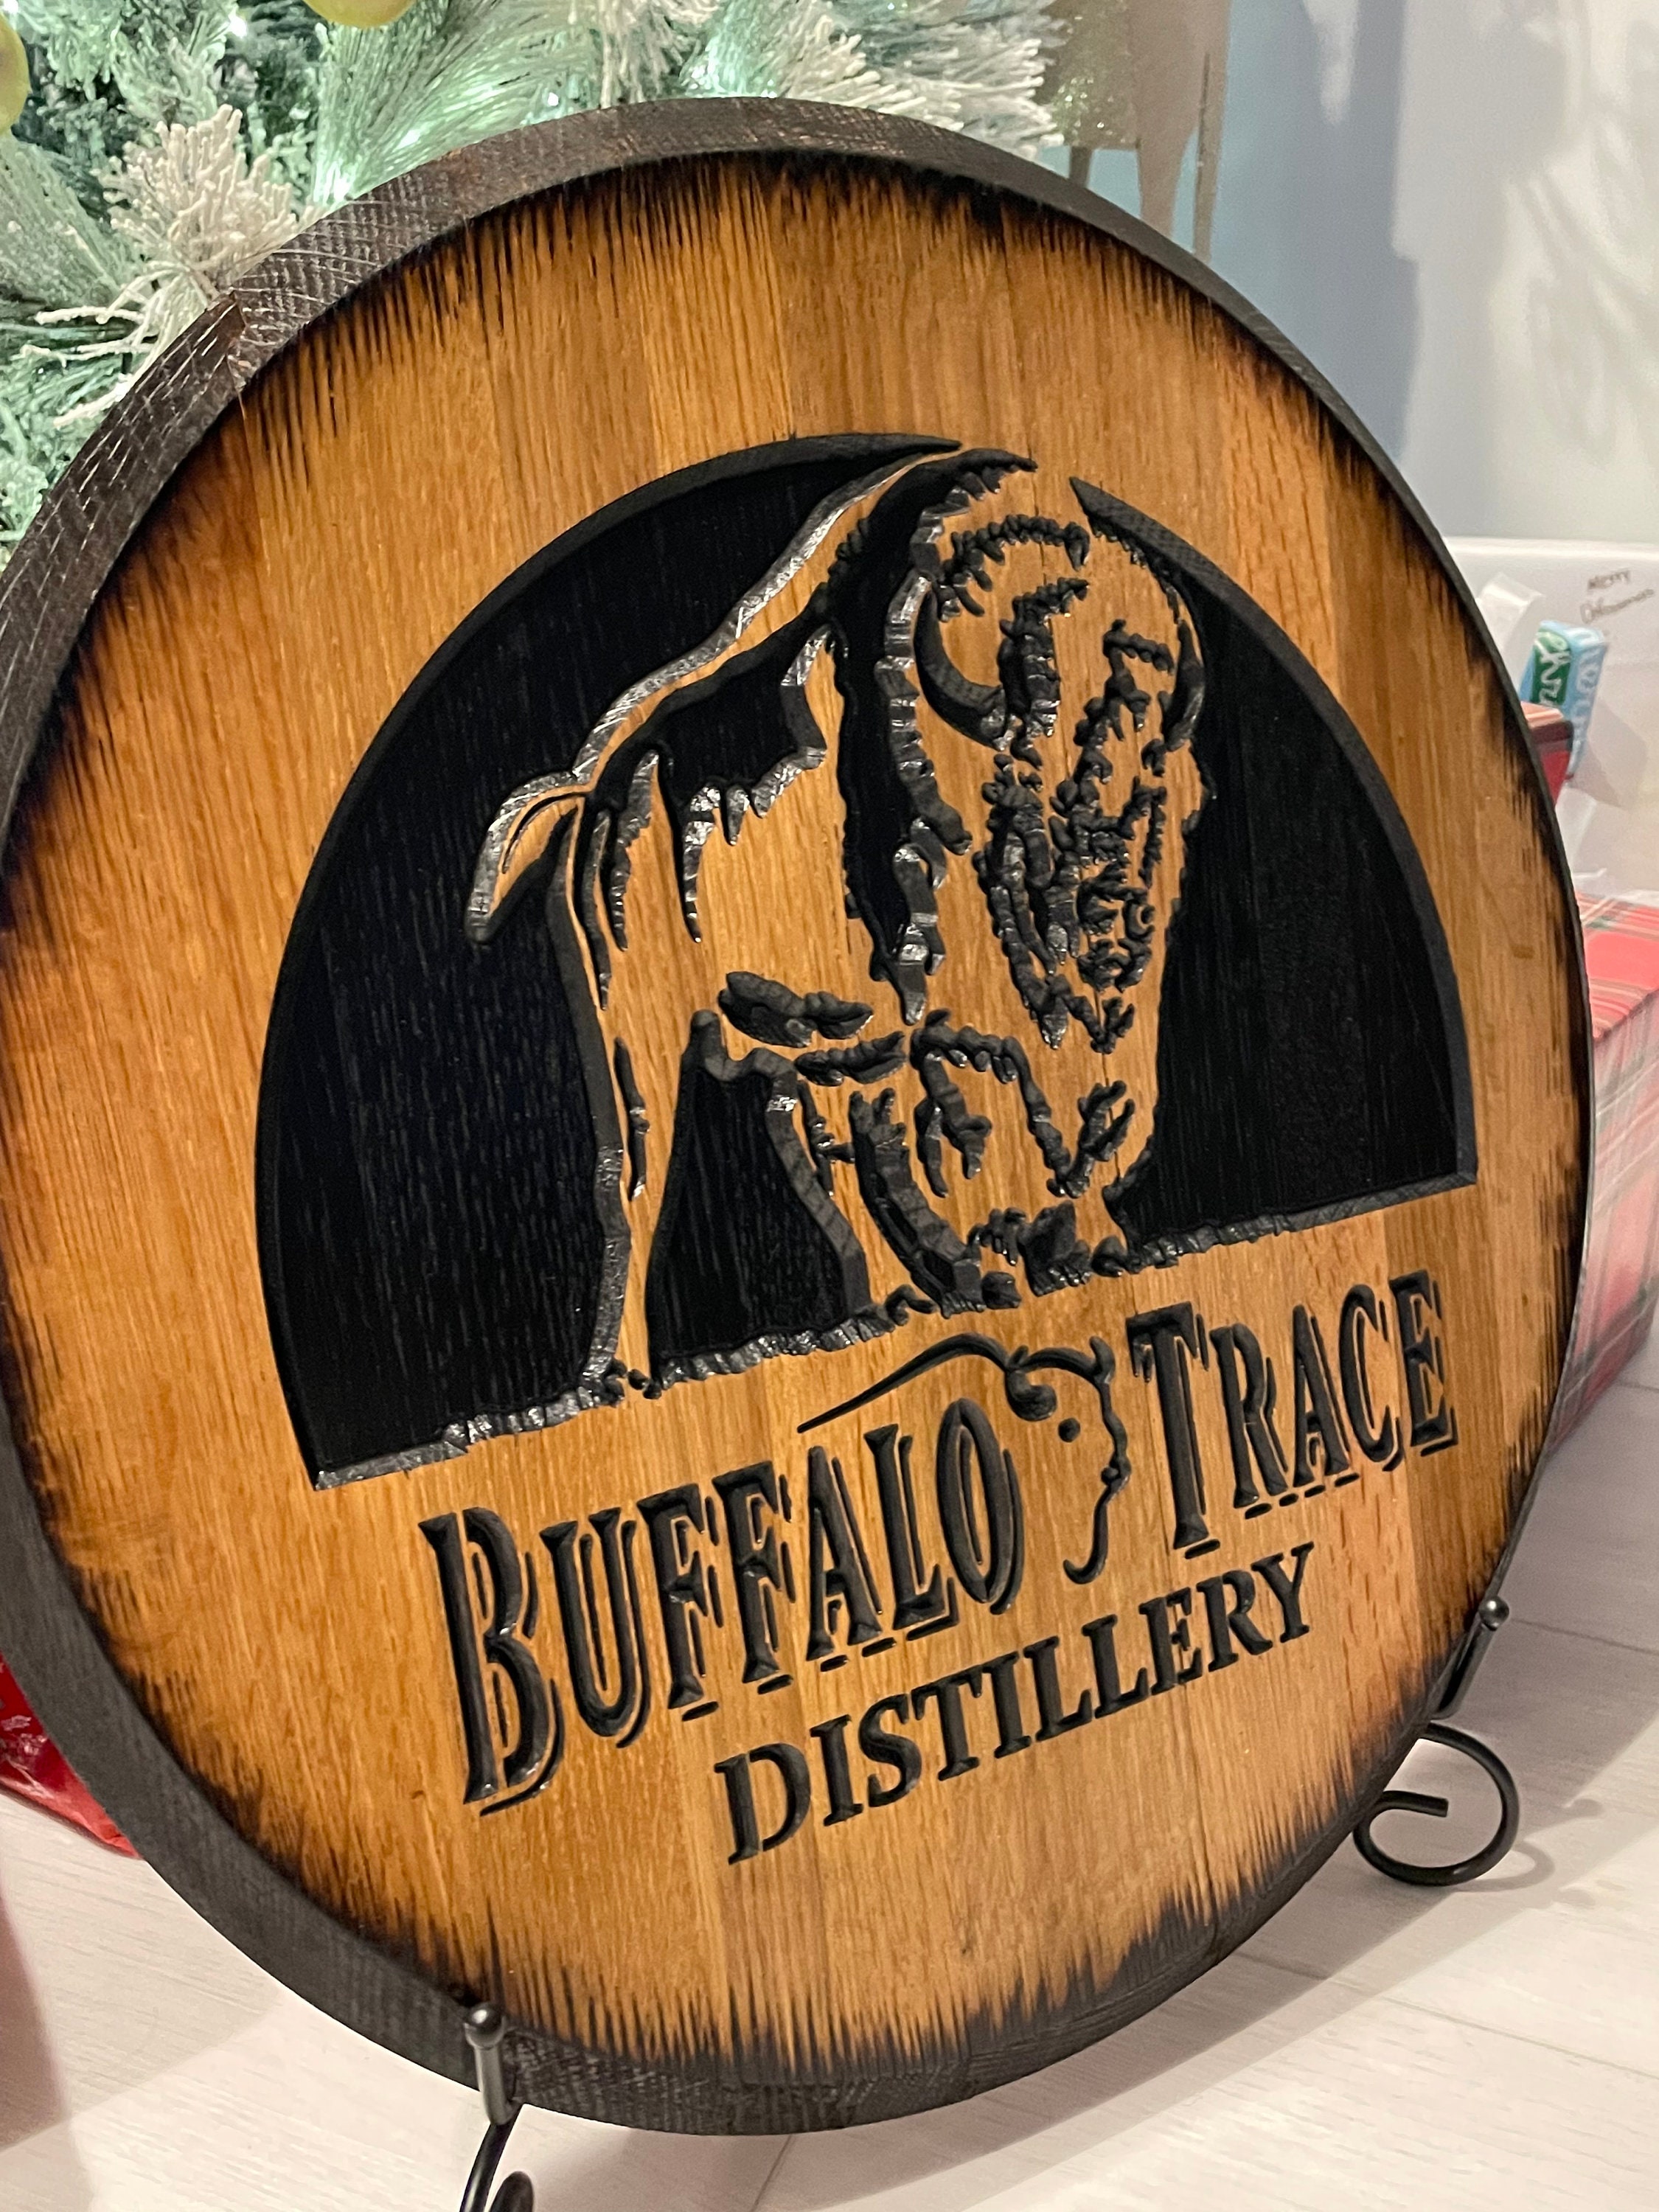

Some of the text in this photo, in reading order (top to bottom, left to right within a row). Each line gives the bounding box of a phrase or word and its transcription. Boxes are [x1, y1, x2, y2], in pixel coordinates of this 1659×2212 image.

[419, 1269, 1458, 1816] BUFFALO TRACE
[713, 1541, 1315, 1865] DISTILLERY
